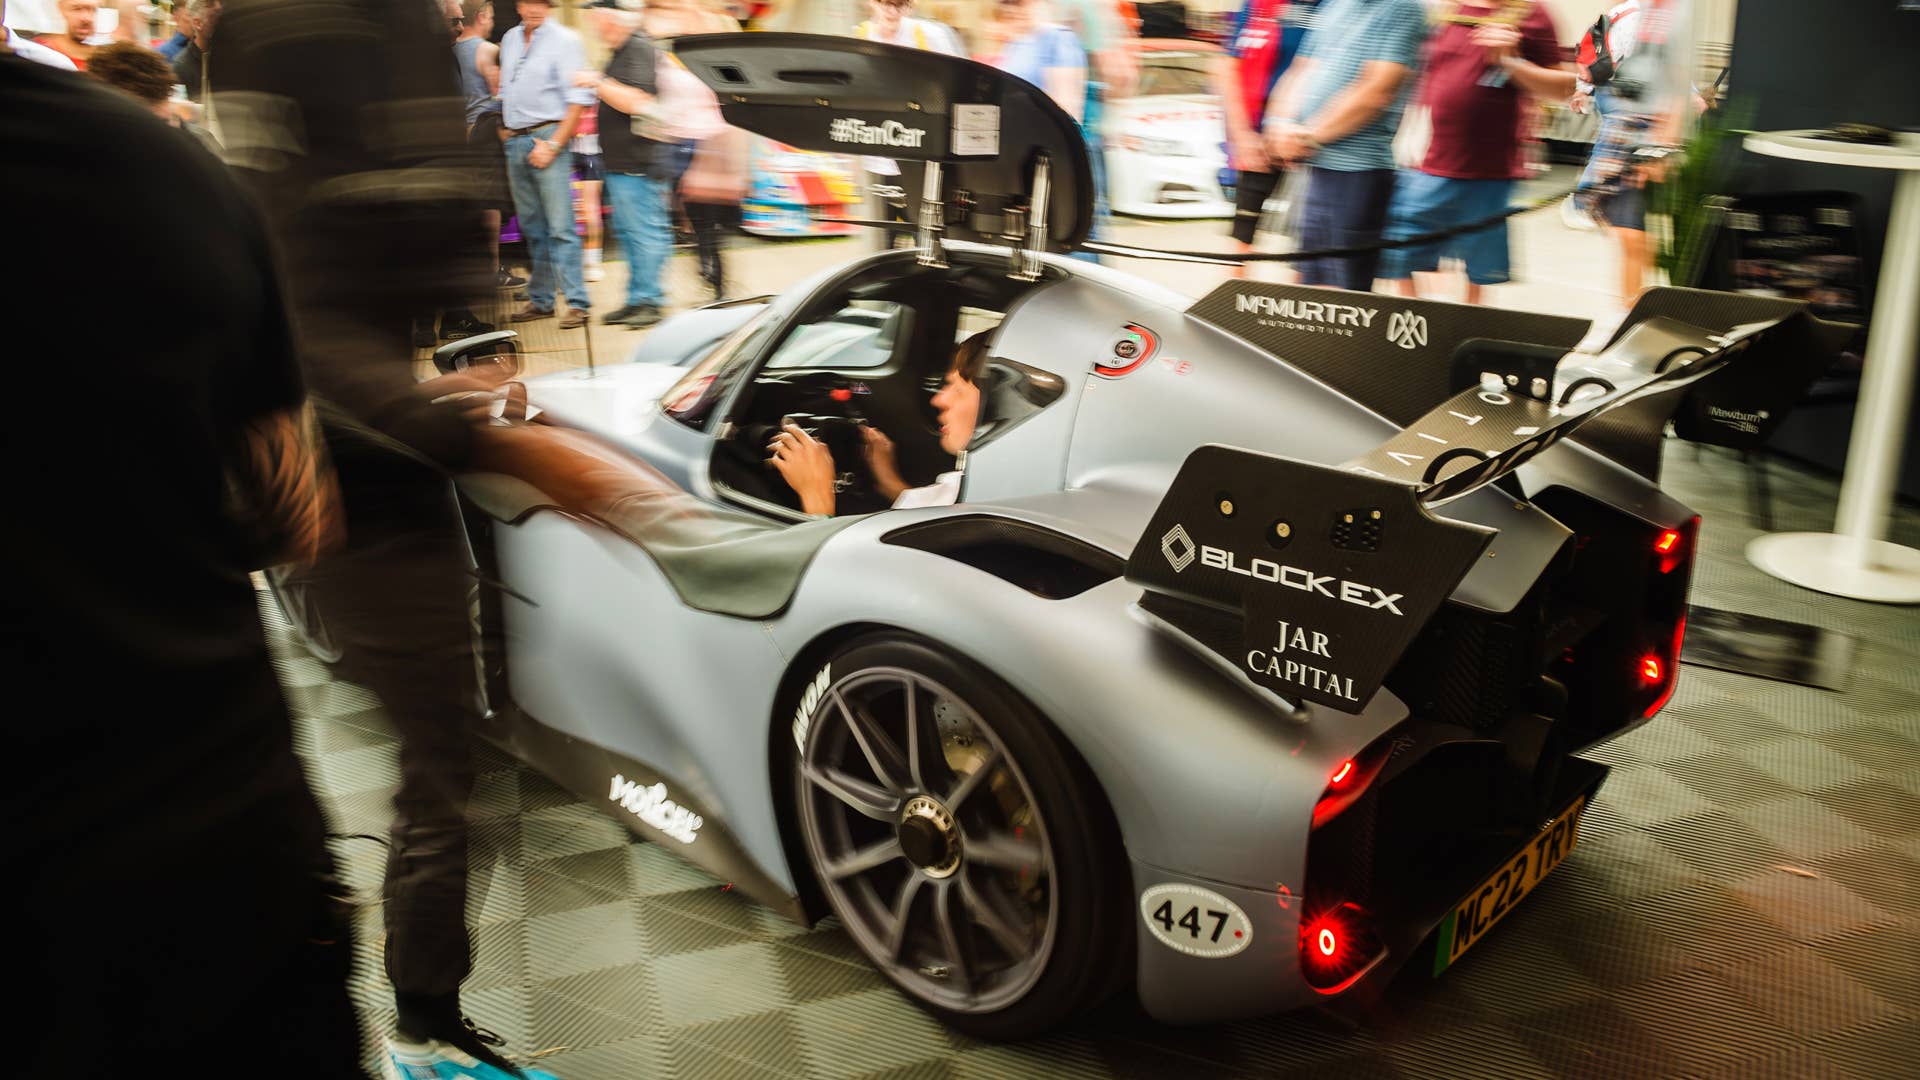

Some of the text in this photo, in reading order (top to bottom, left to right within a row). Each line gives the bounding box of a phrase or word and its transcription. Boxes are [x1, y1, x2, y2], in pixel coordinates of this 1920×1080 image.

[829, 117, 927, 148] #FanCar
[1272, 620, 1332, 658] JAR
[1246, 649, 1360, 702] CAPITAL
[1451, 802, 1583, 958] MC22 TRY
[1152, 899, 1230, 944] 447
